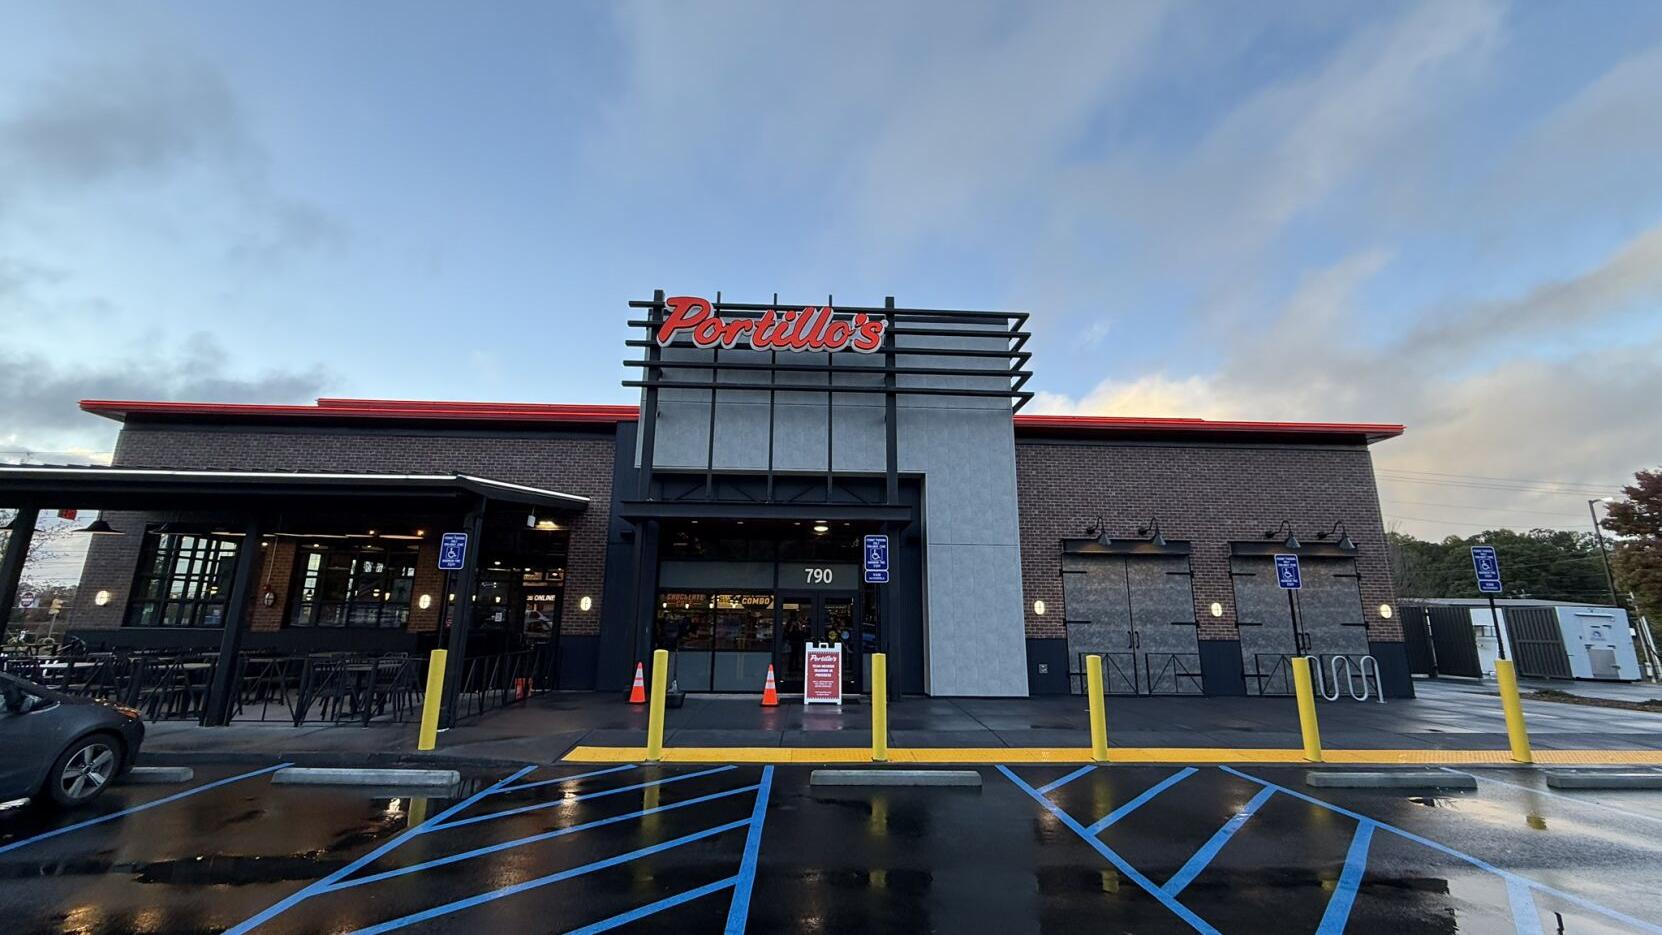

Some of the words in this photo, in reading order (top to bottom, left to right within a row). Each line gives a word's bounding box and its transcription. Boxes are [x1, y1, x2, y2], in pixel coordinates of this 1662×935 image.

[656, 296, 885, 353] Portillo's
[804, 568, 833, 584] 790
[741, 597, 770, 605] COMBO
